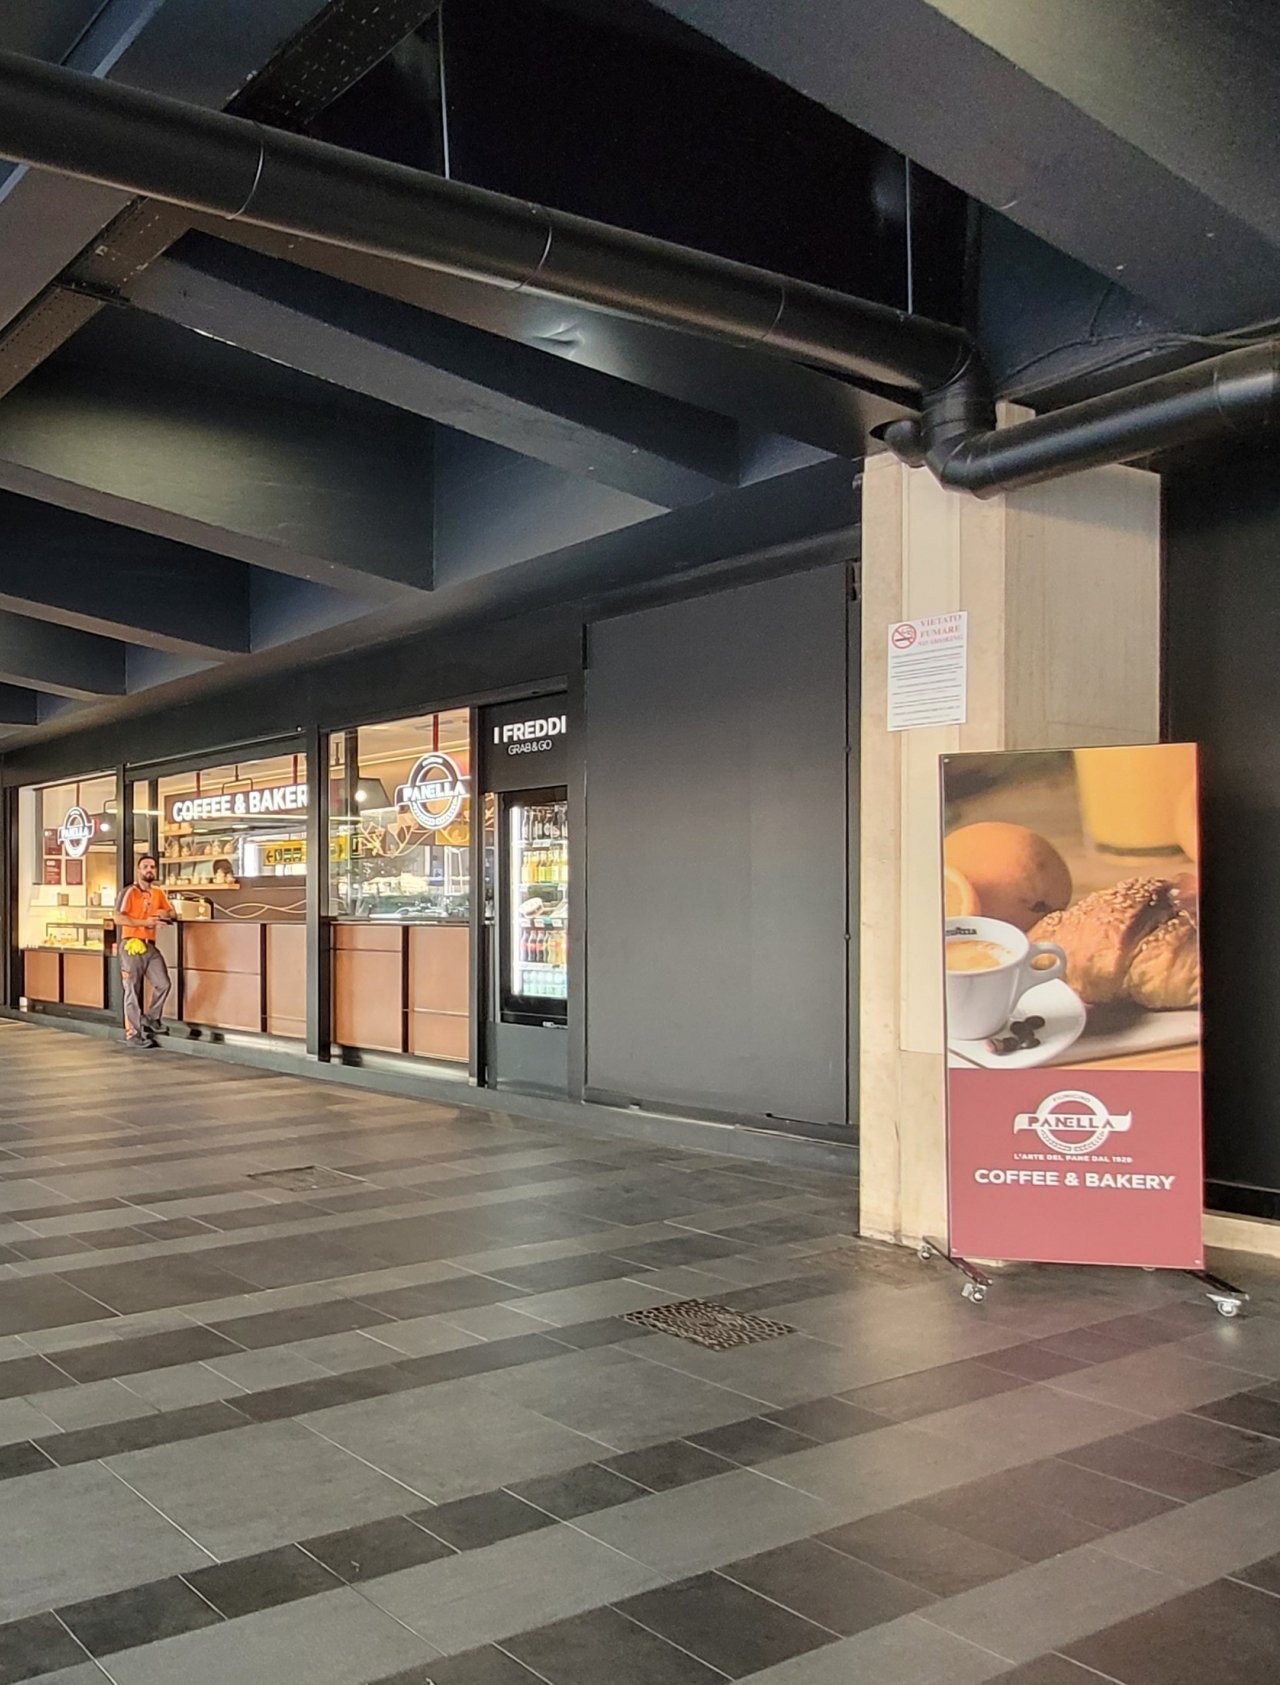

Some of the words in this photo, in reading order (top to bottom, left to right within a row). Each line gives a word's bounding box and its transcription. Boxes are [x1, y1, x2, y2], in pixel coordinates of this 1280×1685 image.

[920, 614, 962, 627] VIETATO
[920, 625, 959, 638] FUMARE
[503, 715, 566, 743] FREDDI
[403, 781, 466, 802] PANELLA
[173, 795, 232, 822] COFFEE
[234, 793, 246, 814] &
[249, 784, 306, 813] BAKER
[1028, 1116, 1115, 1129] PANELLA
[1014, 1153, 1045, 1161] L'ARTE
[974, 1169, 1060, 1185] COFFEE
[1064, 1172, 1080, 1186] &
[1085, 1173, 1176, 1190] BAKERY
